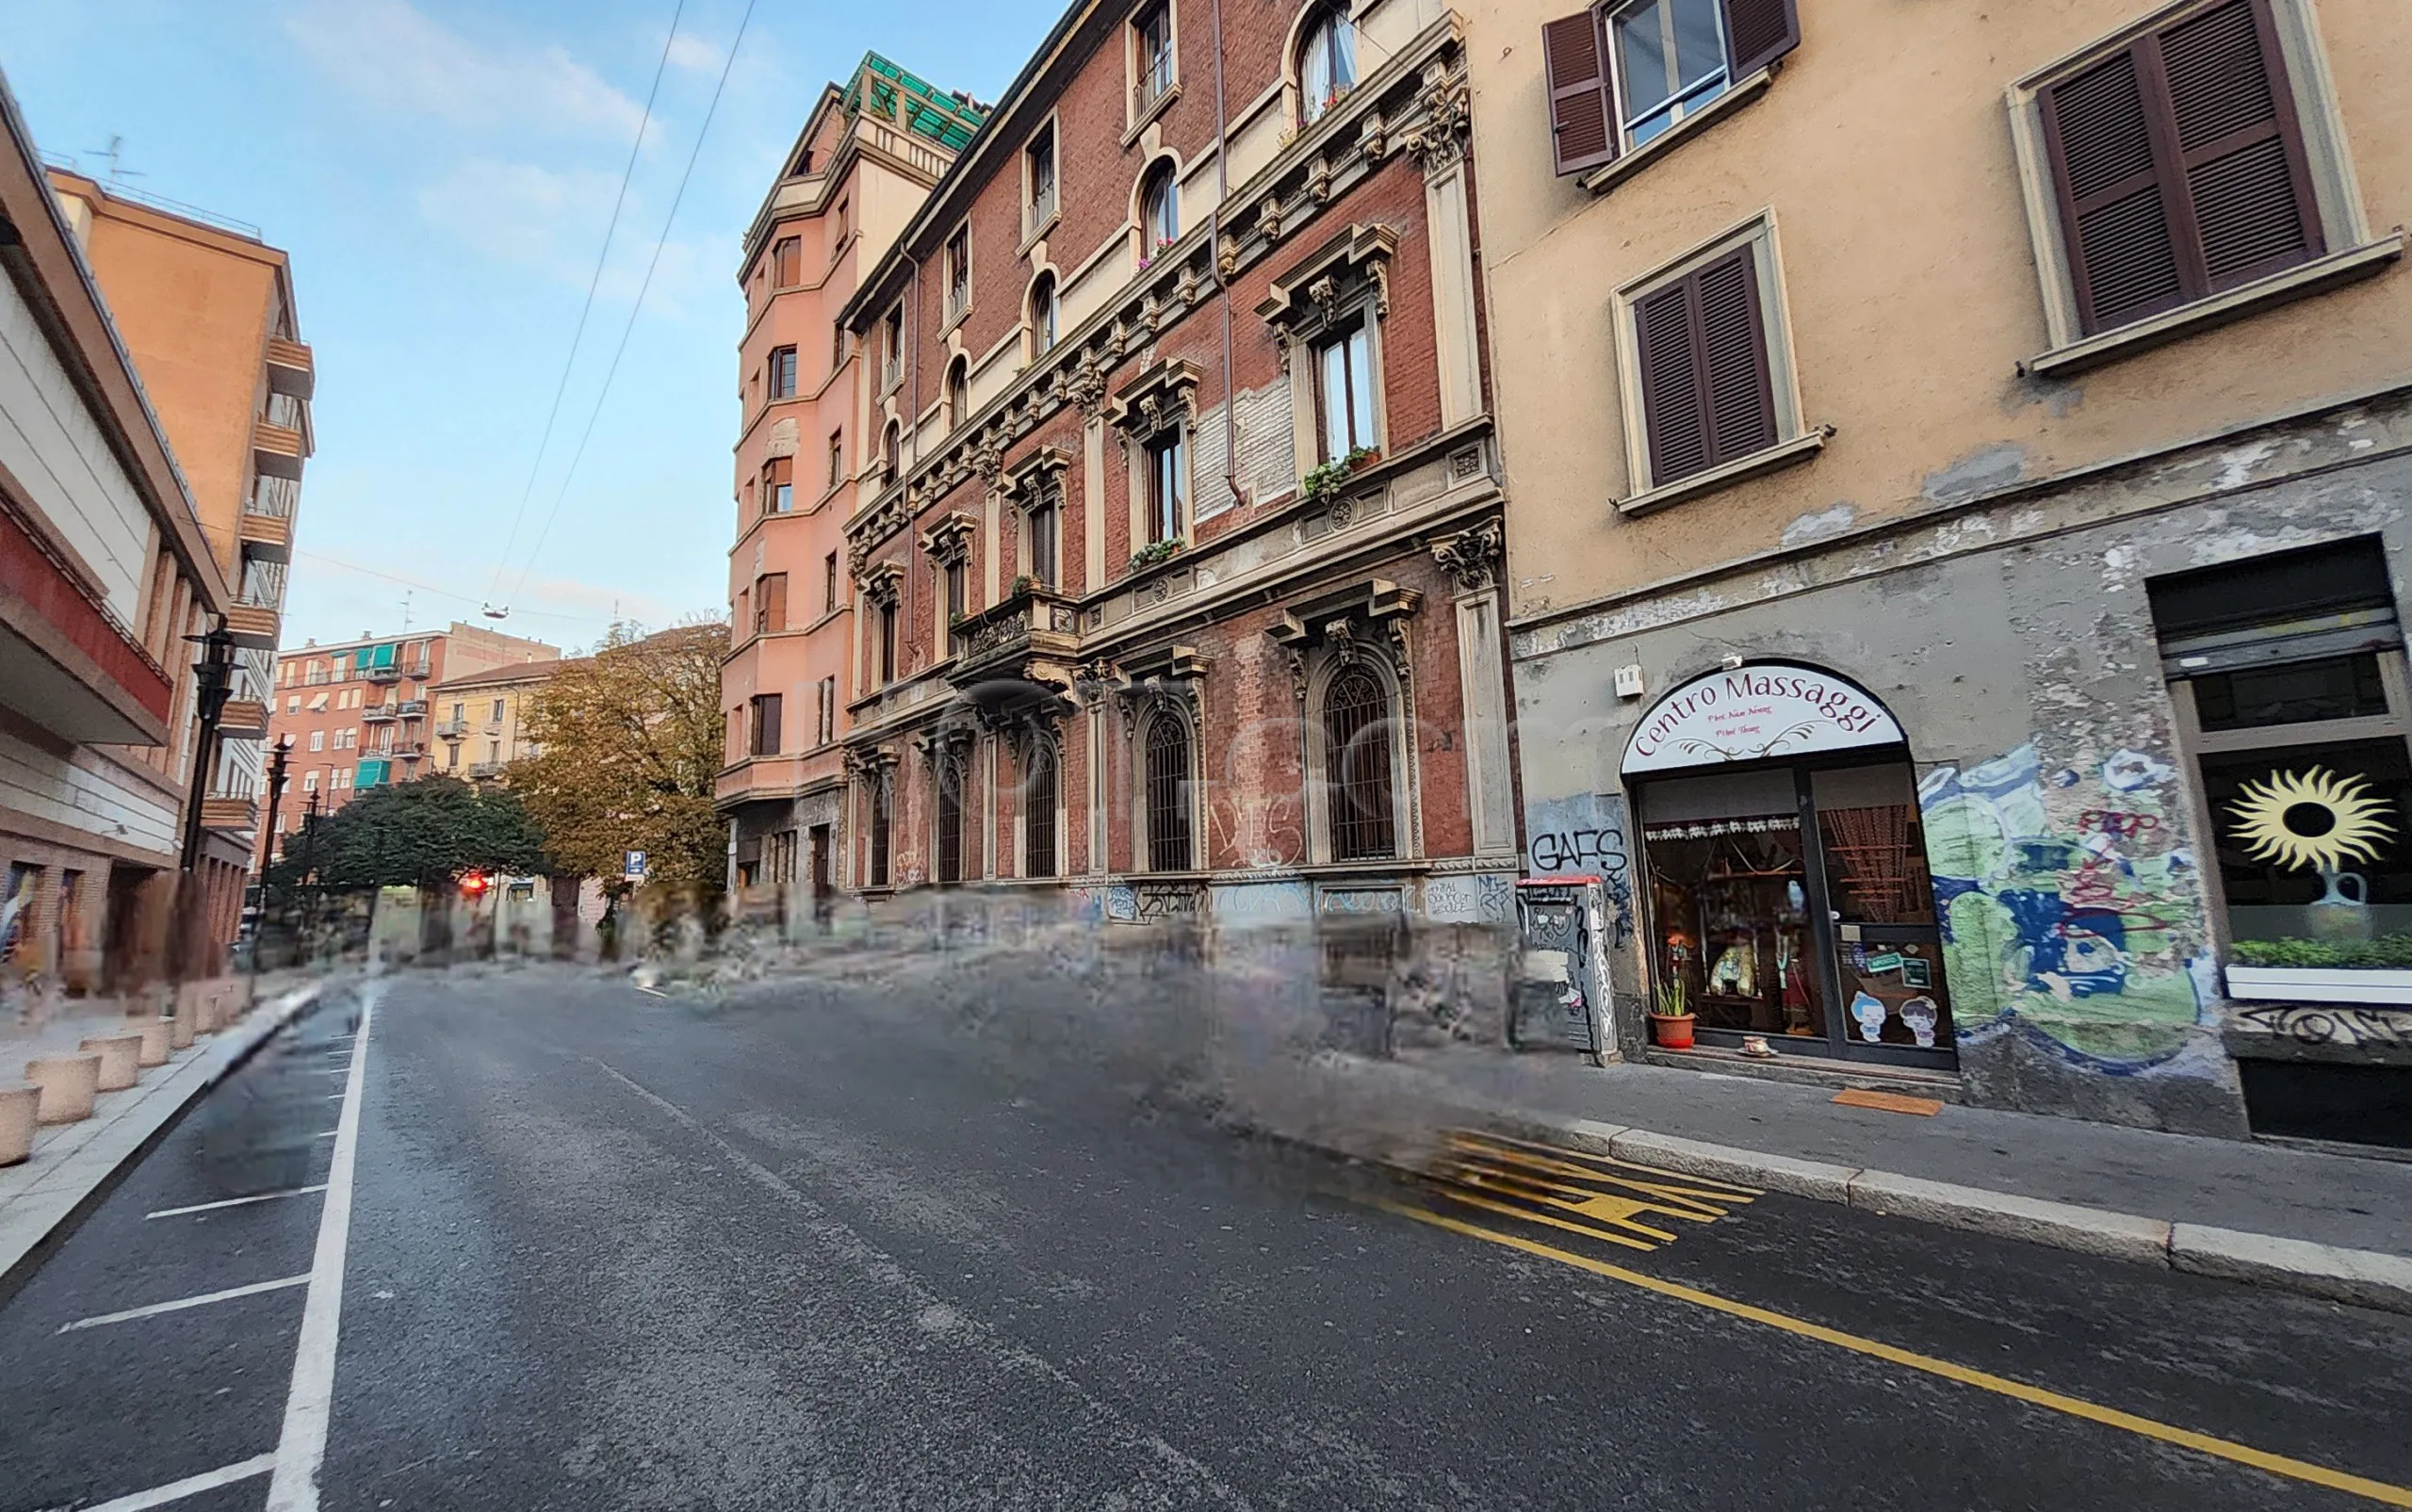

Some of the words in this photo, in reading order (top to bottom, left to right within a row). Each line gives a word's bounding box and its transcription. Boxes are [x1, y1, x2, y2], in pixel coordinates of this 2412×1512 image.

[1636, 686, 1717, 756] Centro
[1725, 673, 1882, 734] Massaggi
[630, 852, 643, 865] P
[1531, 829, 1628, 871] GAFS
